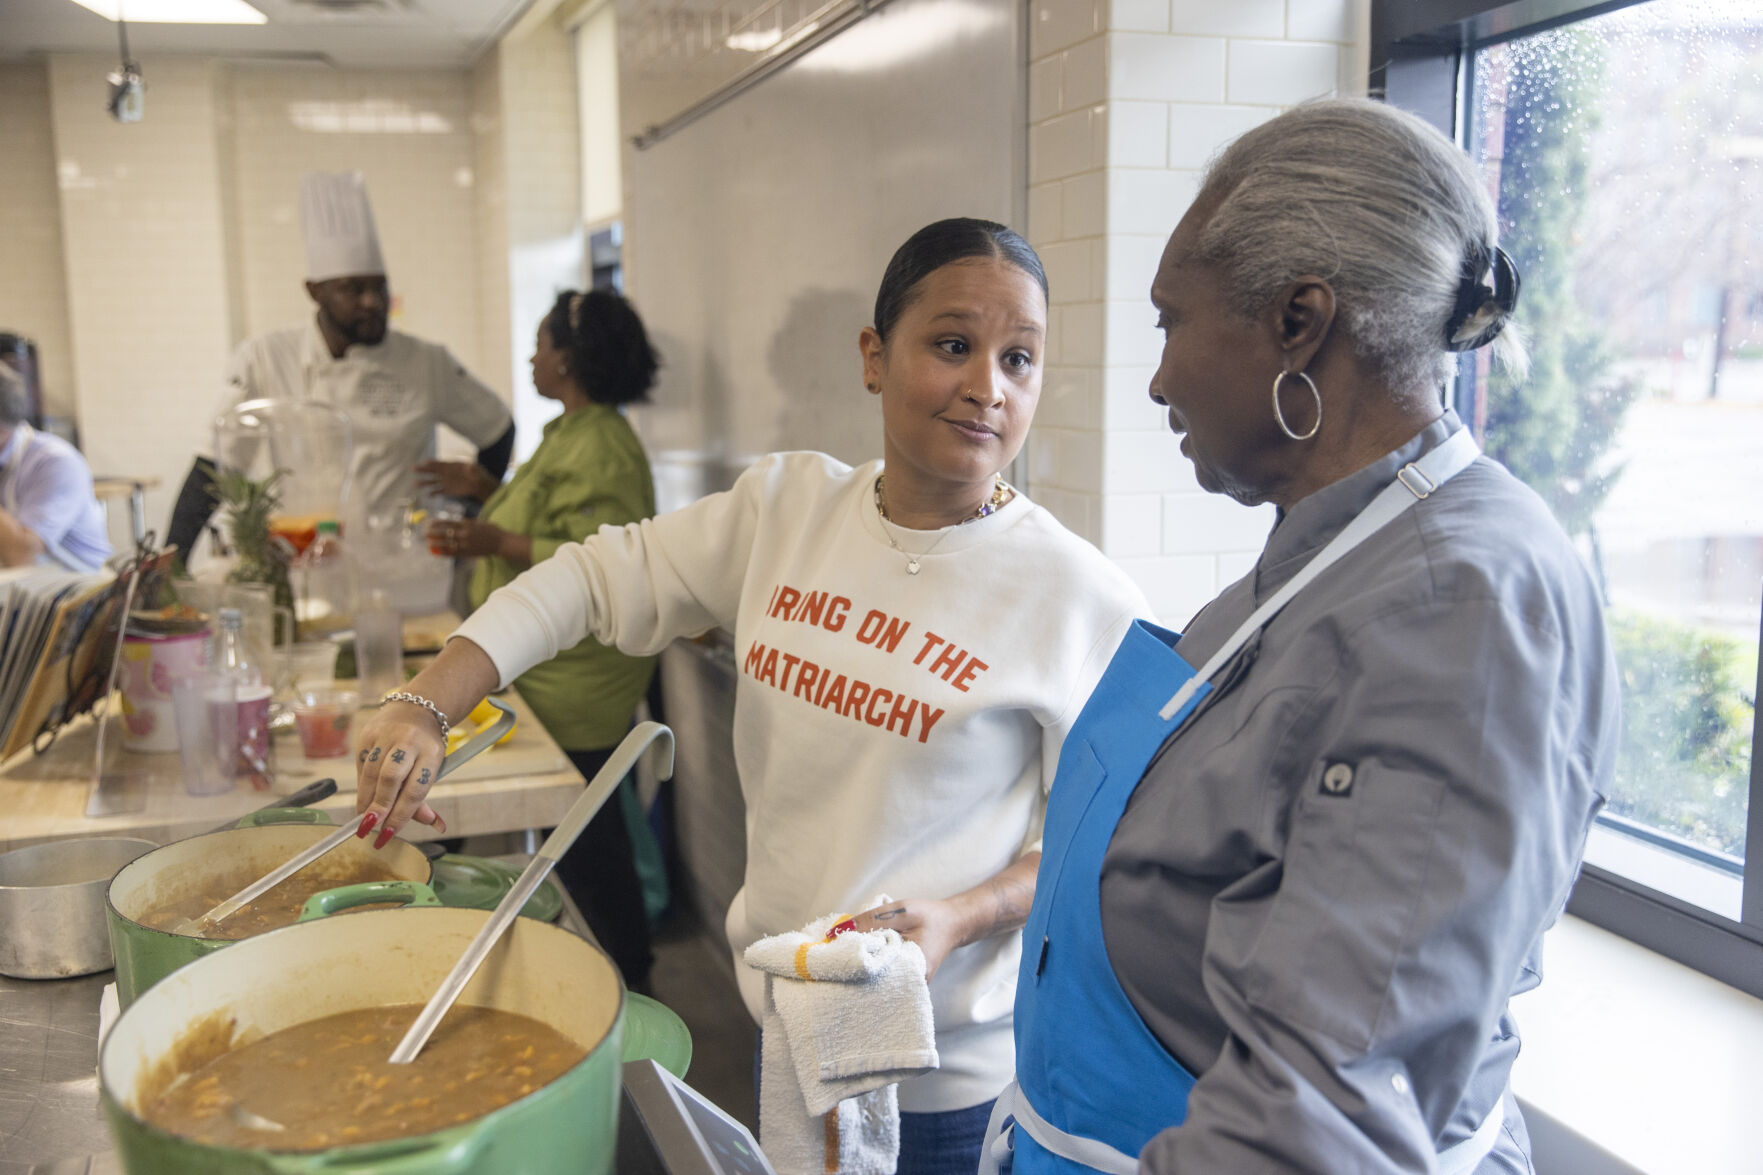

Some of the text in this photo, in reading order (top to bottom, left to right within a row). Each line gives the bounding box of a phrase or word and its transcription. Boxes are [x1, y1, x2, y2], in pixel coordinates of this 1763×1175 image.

[744, 640, 945, 744] MATRIARCHY
[856, 609, 911, 654] ON
[912, 631, 990, 693] THE
